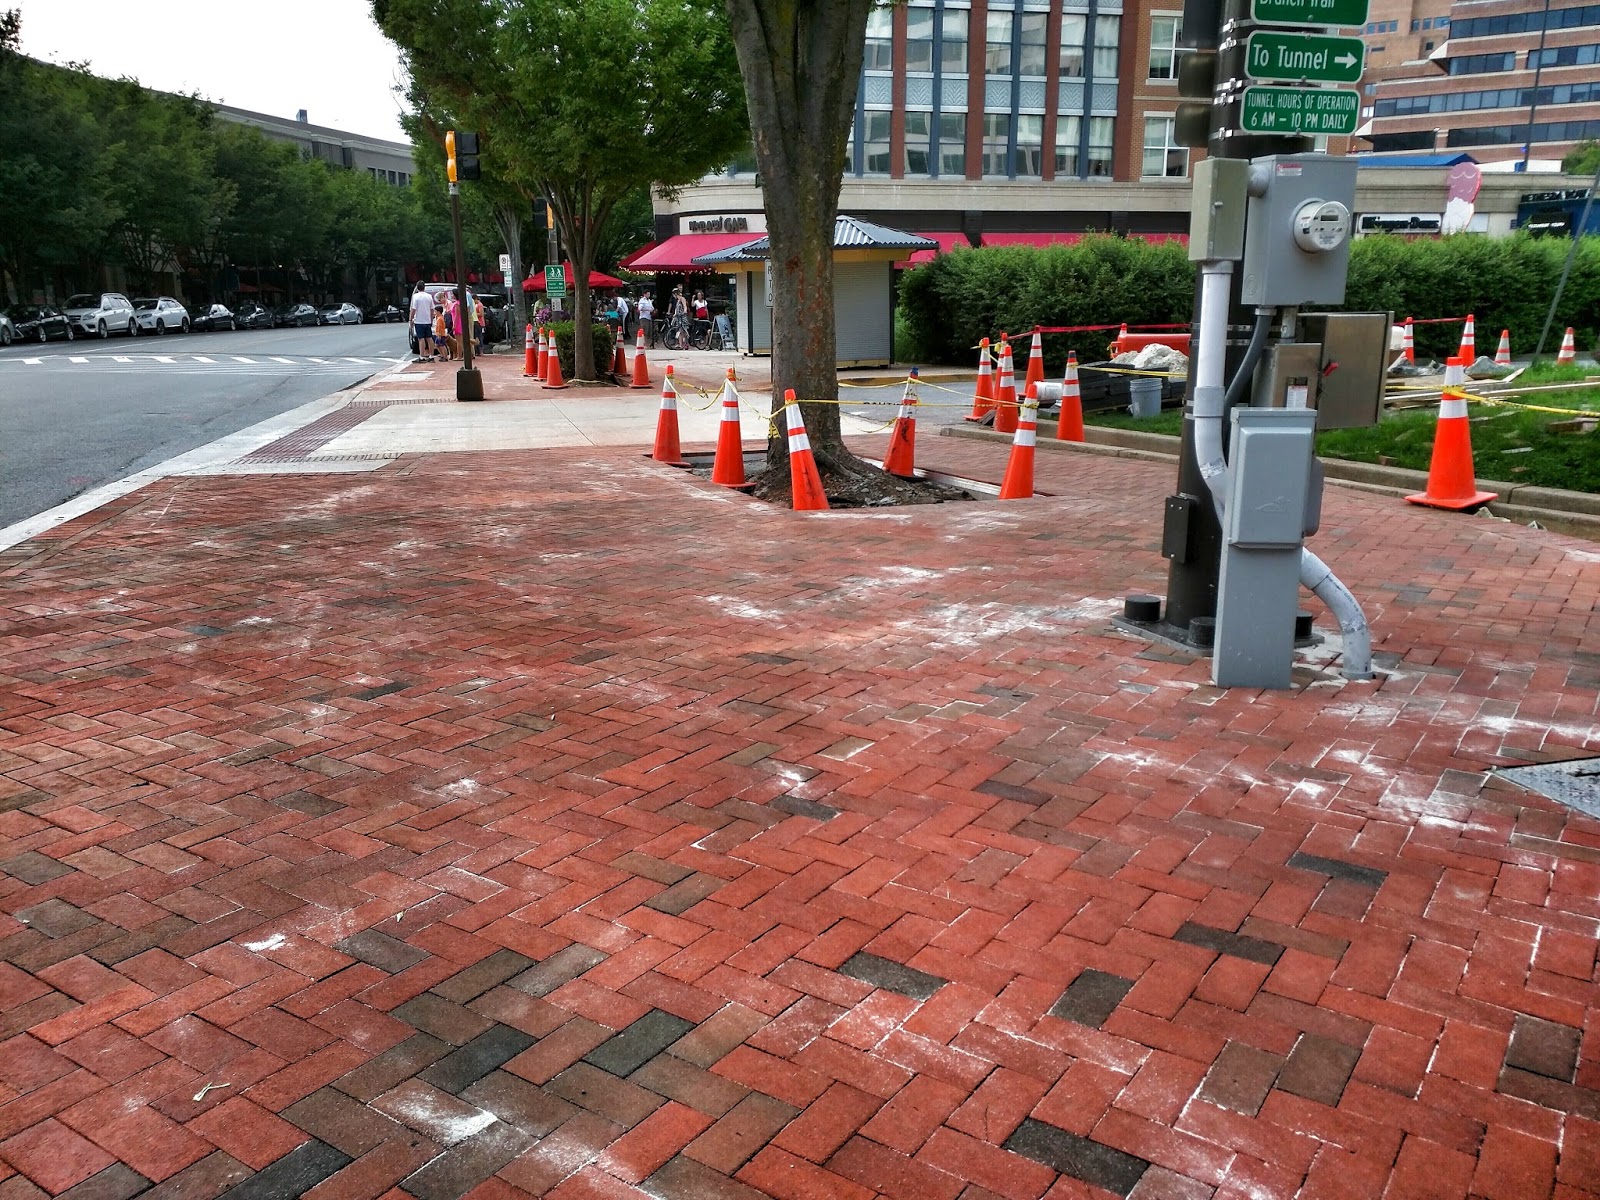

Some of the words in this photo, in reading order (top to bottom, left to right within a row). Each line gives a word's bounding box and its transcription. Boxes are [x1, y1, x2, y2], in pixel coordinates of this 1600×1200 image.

[1253, 43, 1270, 67] To
[1277, 45, 1328, 70] Tunnel
[1247, 92, 1275, 108] TUNNEL
[1277, 93, 1302, 109] HOURS
[1304, 94, 1316, 110] OF
[1317, 95, 1357, 111] OPERATION
[1251, 111, 1258, 127] 6
[1261, 111, 1276, 127] AM
[1291, 112, 1301, 128] 10
[1304, 113, 1319, 129] PM
[1322, 113, 1349, 129] DAILY
